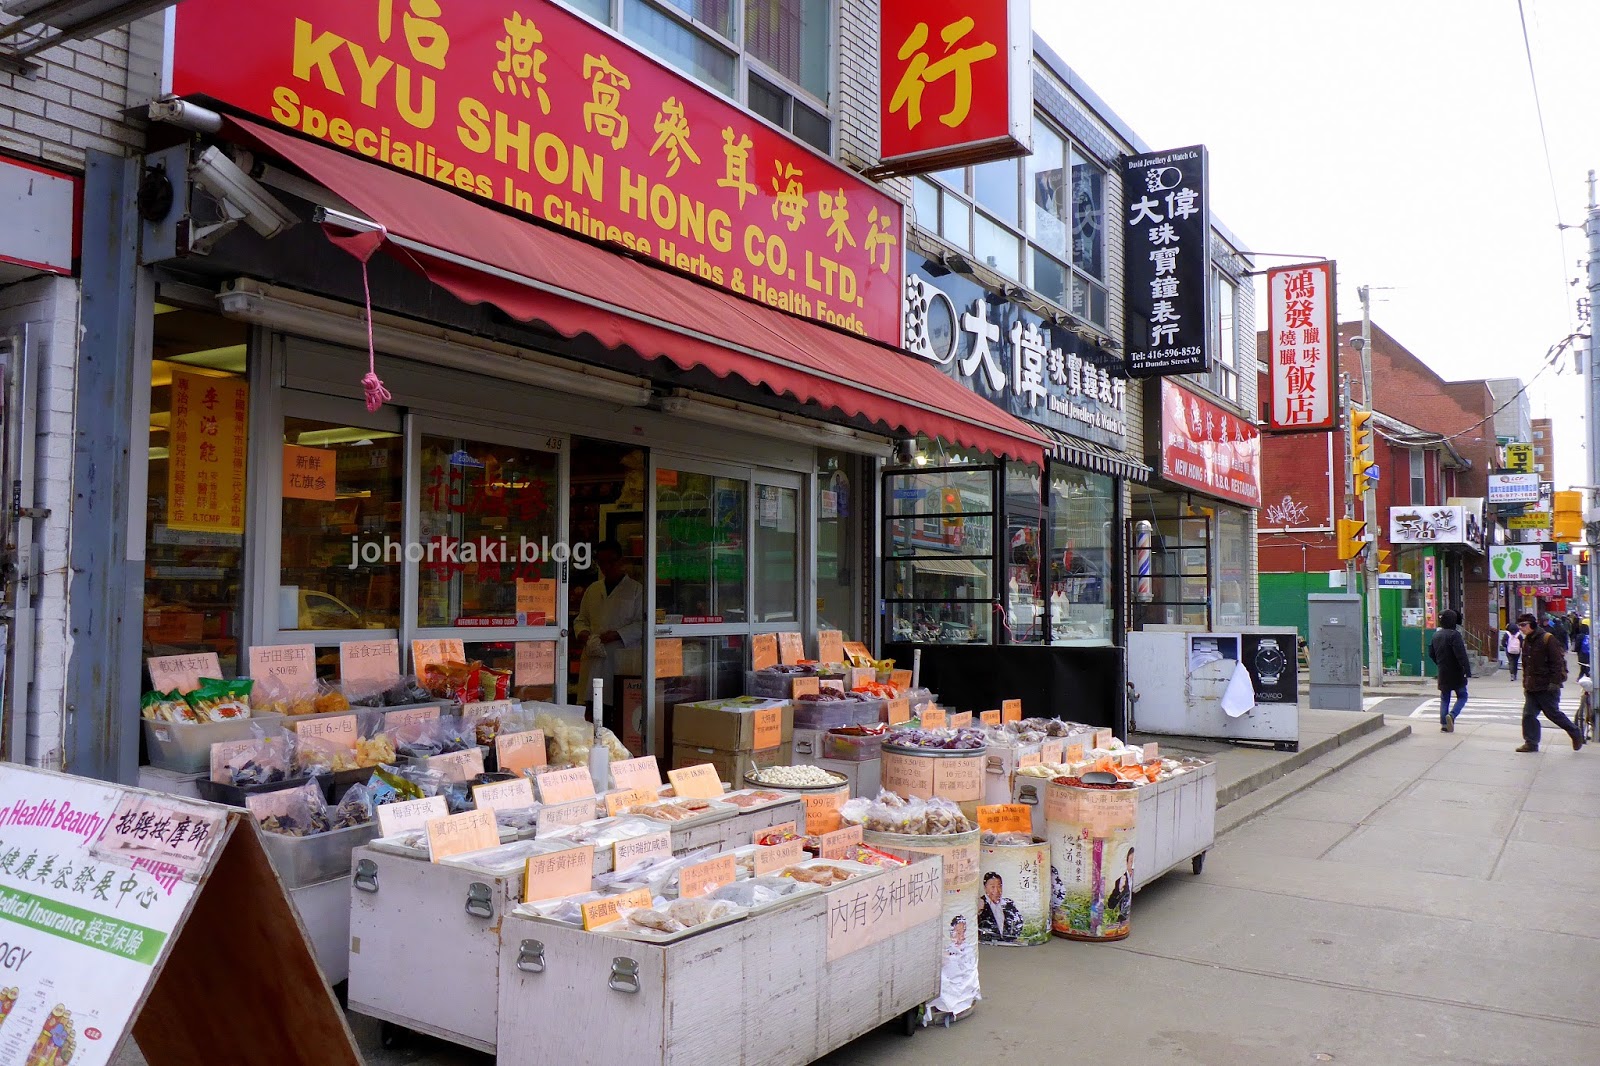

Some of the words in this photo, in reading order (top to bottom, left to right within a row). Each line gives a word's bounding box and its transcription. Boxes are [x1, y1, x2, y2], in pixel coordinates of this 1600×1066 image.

[889, 16, 998, 131] 行
[293, 18, 436, 129] KYU
[456, 97, 604, 203] SHON
[620, 165, 732, 253] HONG
[744, 225, 796, 280] CO.
[806, 251, 864, 308] LTD.
[493, 11, 897, 274] 燕窩參茸海味行
[1129, 161, 1144, 170] David
[1144, 155, 1166, 167] Jewellery
[1172, 152, 1189, 162] Watch
[271, 86, 494, 200] Specializes
[505, 177, 533, 215] In
[543, 193, 651, 254] Chinese
[659, 238, 724, 284] Herbs
[730, 268, 747, 293] &
[752, 275, 812, 318] Health
[817, 300, 867, 337] Foods.
[1129, 187, 1200, 226] 大偉
[1148, 223, 1181, 347] 珠寶鐘表行
[1284, 270, 1316, 328] 鴻發
[960, 298, 1048, 408] 大偉
[1131, 352, 1146, 361] Tel:
[1147, 346, 1201, 360] 416-596-8526
[1145, 359, 1170, 368] Dundas
[1171, 357, 1190, 366] Street
[1285, 366, 1317, 424] 飯店
[296, 455, 321, 469] 新鮮
[546, 437, 562, 450] 439
[1256, 692, 1283, 700] MOVADO
[6, 798, 57, 827] Health
[50, 801, 105, 846] Beauty
[0, 890, 32, 919] edical
[28, 899, 86, 936] Insurance
[830, 867, 940, 939] 內有多种蝦米
[83, 916, 144, 956] 接受保險
